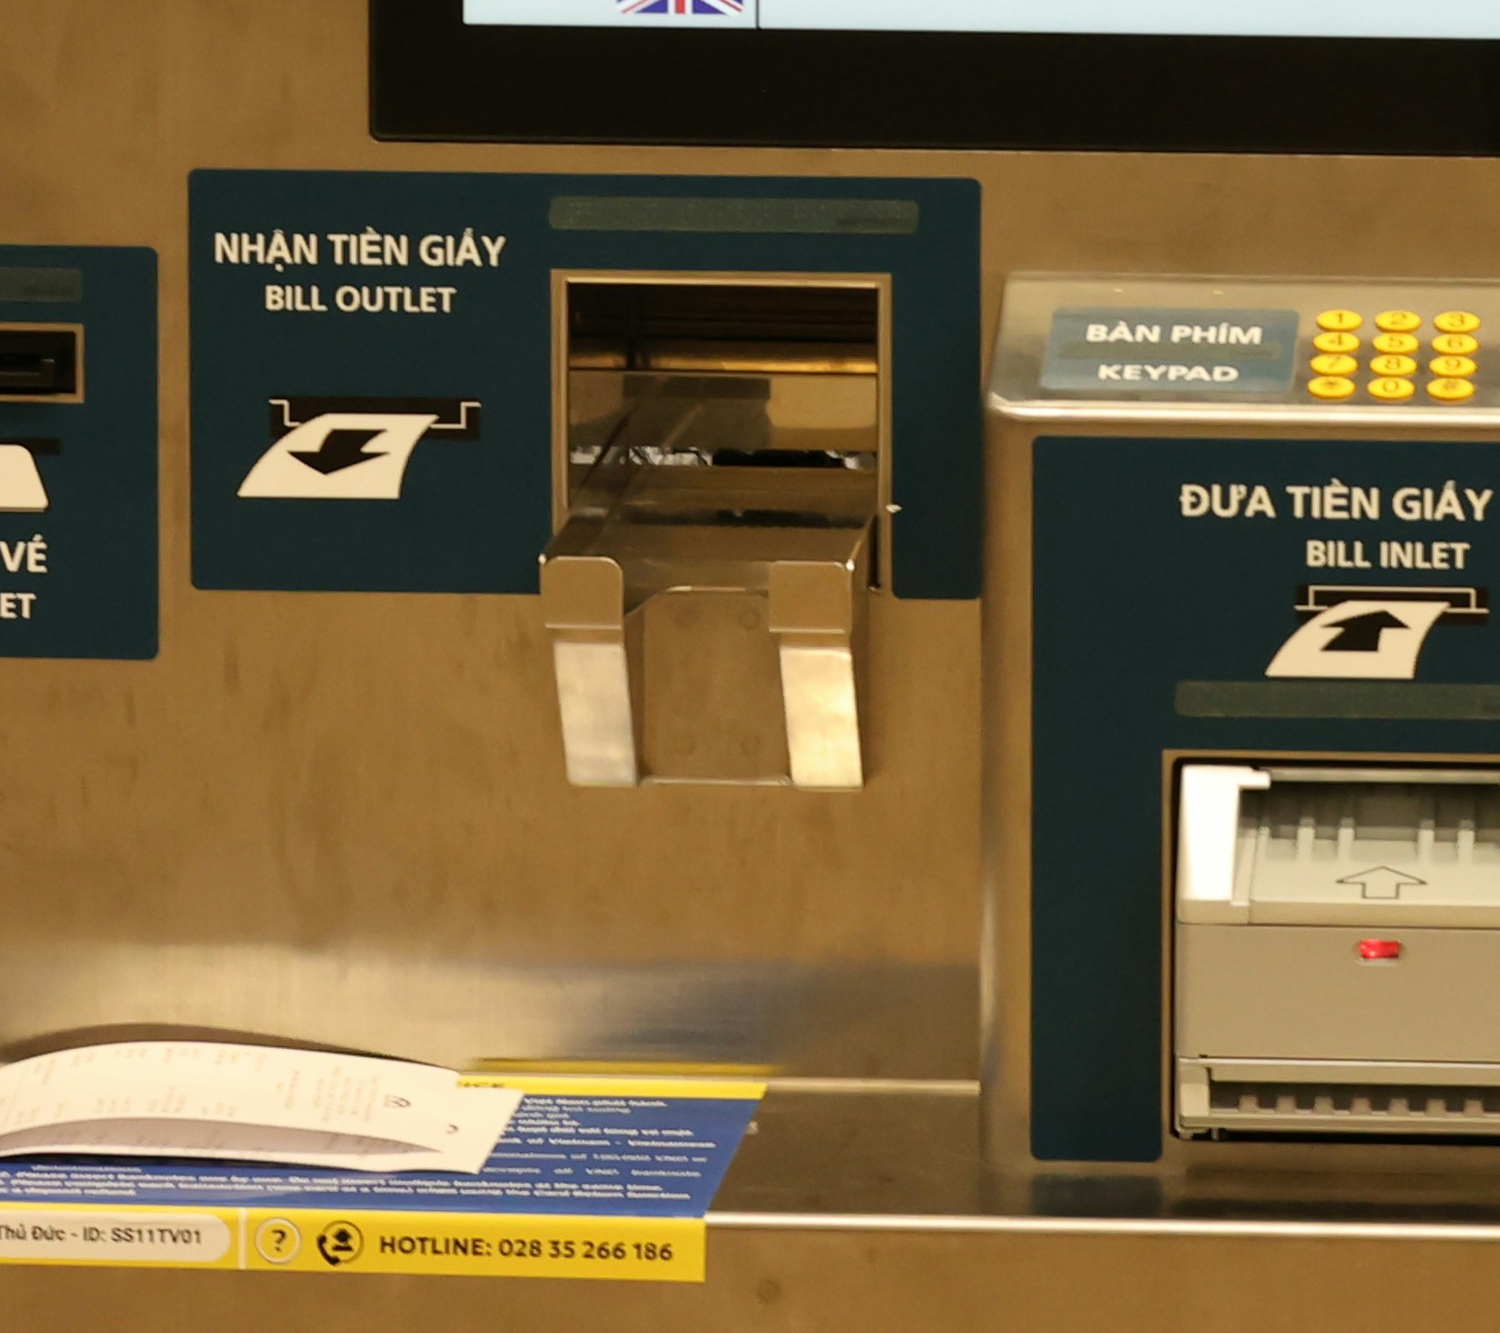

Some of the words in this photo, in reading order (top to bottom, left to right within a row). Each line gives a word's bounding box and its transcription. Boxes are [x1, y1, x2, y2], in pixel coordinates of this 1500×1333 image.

[1086, 321, 1161, 343] BÀN
[1171, 322, 1262, 344] PHÍM
[1098, 365, 1239, 382] KEYPAD
[31, 1225, 66, 1242] Đức
[83, 1227, 106, 1243] ID:
[110, 1227, 201, 1244] SS11TV01
[380, 1236, 492, 1257] HOTLINE:
[498, 1239, 542, 1258] 028
[548, 1240, 575, 1259] 35
[582, 1241, 627, 1260] 266
[632, 1242, 673, 1261] 186
